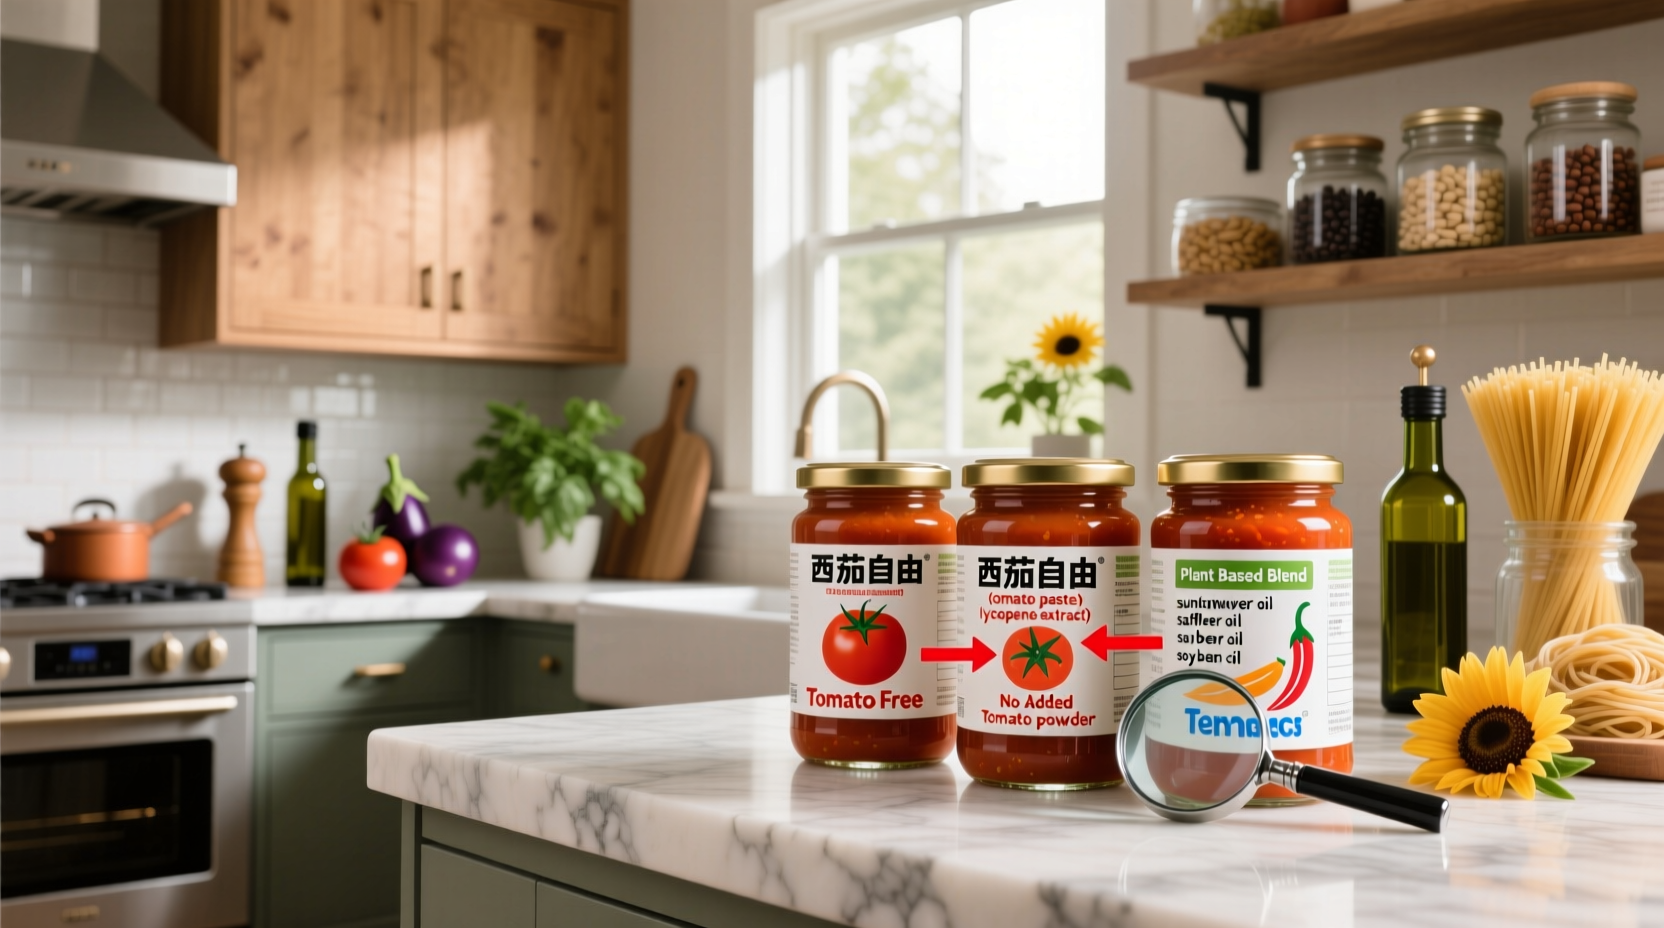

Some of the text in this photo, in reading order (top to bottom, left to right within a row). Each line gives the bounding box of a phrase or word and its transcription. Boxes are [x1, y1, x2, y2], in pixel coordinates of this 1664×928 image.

[811, 553, 923, 585] 西茄自由
[978, 556, 1097, 590] 西茄自由
[1181, 567, 1307, 582] Plant Based Blend
[1039, 593, 1083, 609] paste)
[1257, 596, 1273, 610] oil
[1225, 613, 1241, 627] oil
[1227, 631, 1242, 645] oil
[806, 687, 876, 709] Tomato
[880, 690, 923, 709] Free
[1000, 694, 1073, 709] No Added
[981, 709, 1096, 730] Tomato powder
